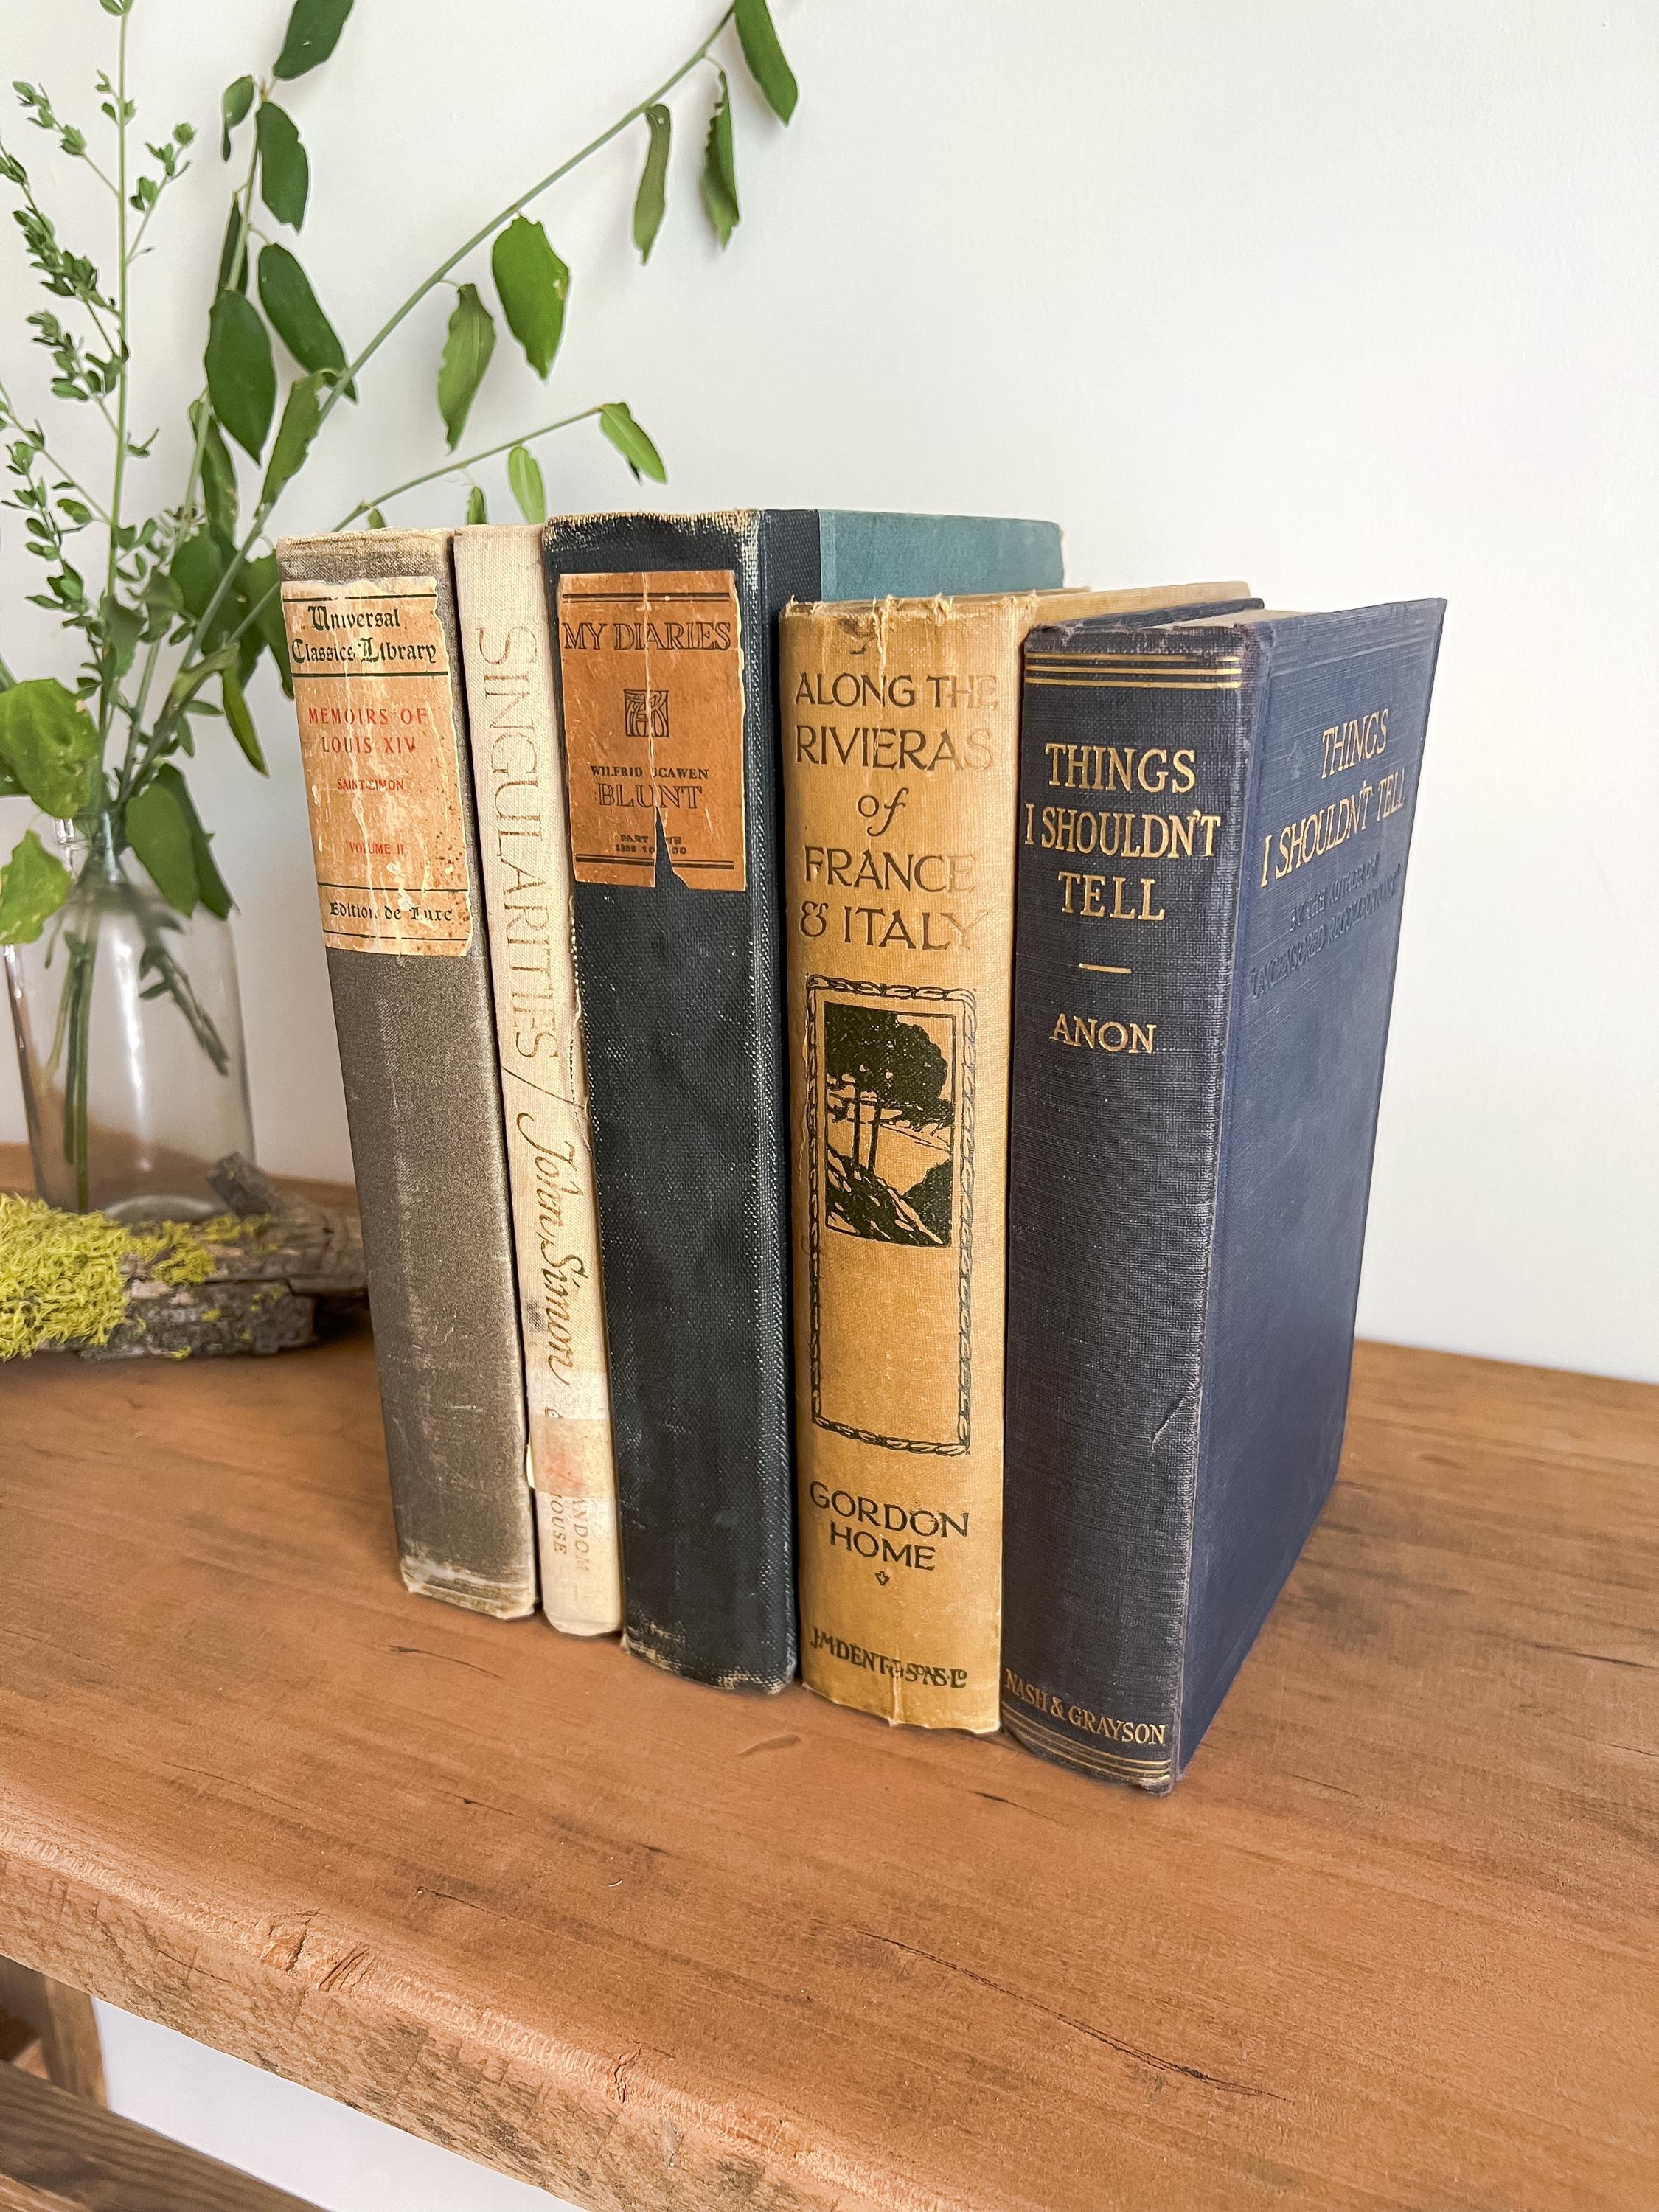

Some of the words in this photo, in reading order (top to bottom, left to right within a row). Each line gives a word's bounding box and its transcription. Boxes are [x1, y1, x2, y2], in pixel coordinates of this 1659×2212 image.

[307, 605, 401, 631] Universal
[562, 622, 608, 650] MY
[613, 622, 731, 650] DIARIES
[291, 638, 355, 664] Classics
[358, 637, 437, 664] Library
[795, 672, 916, 709] ALONG
[926, 675, 998, 710] THE
[308, 708, 388, 725] MEMOIRS
[400, 708, 427, 725] OF
[321, 737, 372, 754] LOUIS
[383, 737, 416, 754] XIV
[795, 725, 994, 772] RIVIERAS
[1044, 742, 1197, 794] THINGS
[1321, 708, 1389, 779] THINGS
[590, 765, 643, 779] WILFRID
[598, 783, 703, 809] BLUNT
[858, 787, 909, 837] of
[1024, 804, 1034, 845] I
[1041, 807, 1222, 858] SHOULDN'T
[1260, 835, 1273, 888] I
[1276, 779, 1374, 880] SHOULDN'T
[1376, 768, 1405, 822] TELL
[349, 842, 391, 855] VOLUME
[397, 844, 404, 855] II
[477, 626, 560, 1059] SINGULARITIES
[619, 834, 649, 844] PART
[666, 836, 682, 844] NE
[803, 846, 978, 895] FRANCE
[384, 905, 401, 920] de
[1058, 871, 1166, 921] TELL
[799, 900, 829, 939] &
[843, 905, 989, 950] ITALY
[1049, 1012, 1157, 1055] ANON
[516, 1113, 584, 1237] John
[539, 1234, 589, 1386] Simon
[810, 1480, 970, 1538] GORDON
[571, 1497, 591, 1572] ANDOM
[830, 1521, 936, 1572] HOME
[1004, 1669, 1048, 1713] NASH
[1050, 1697, 1065, 1718] &
[1068, 1705, 1168, 1747] GRAYSON
